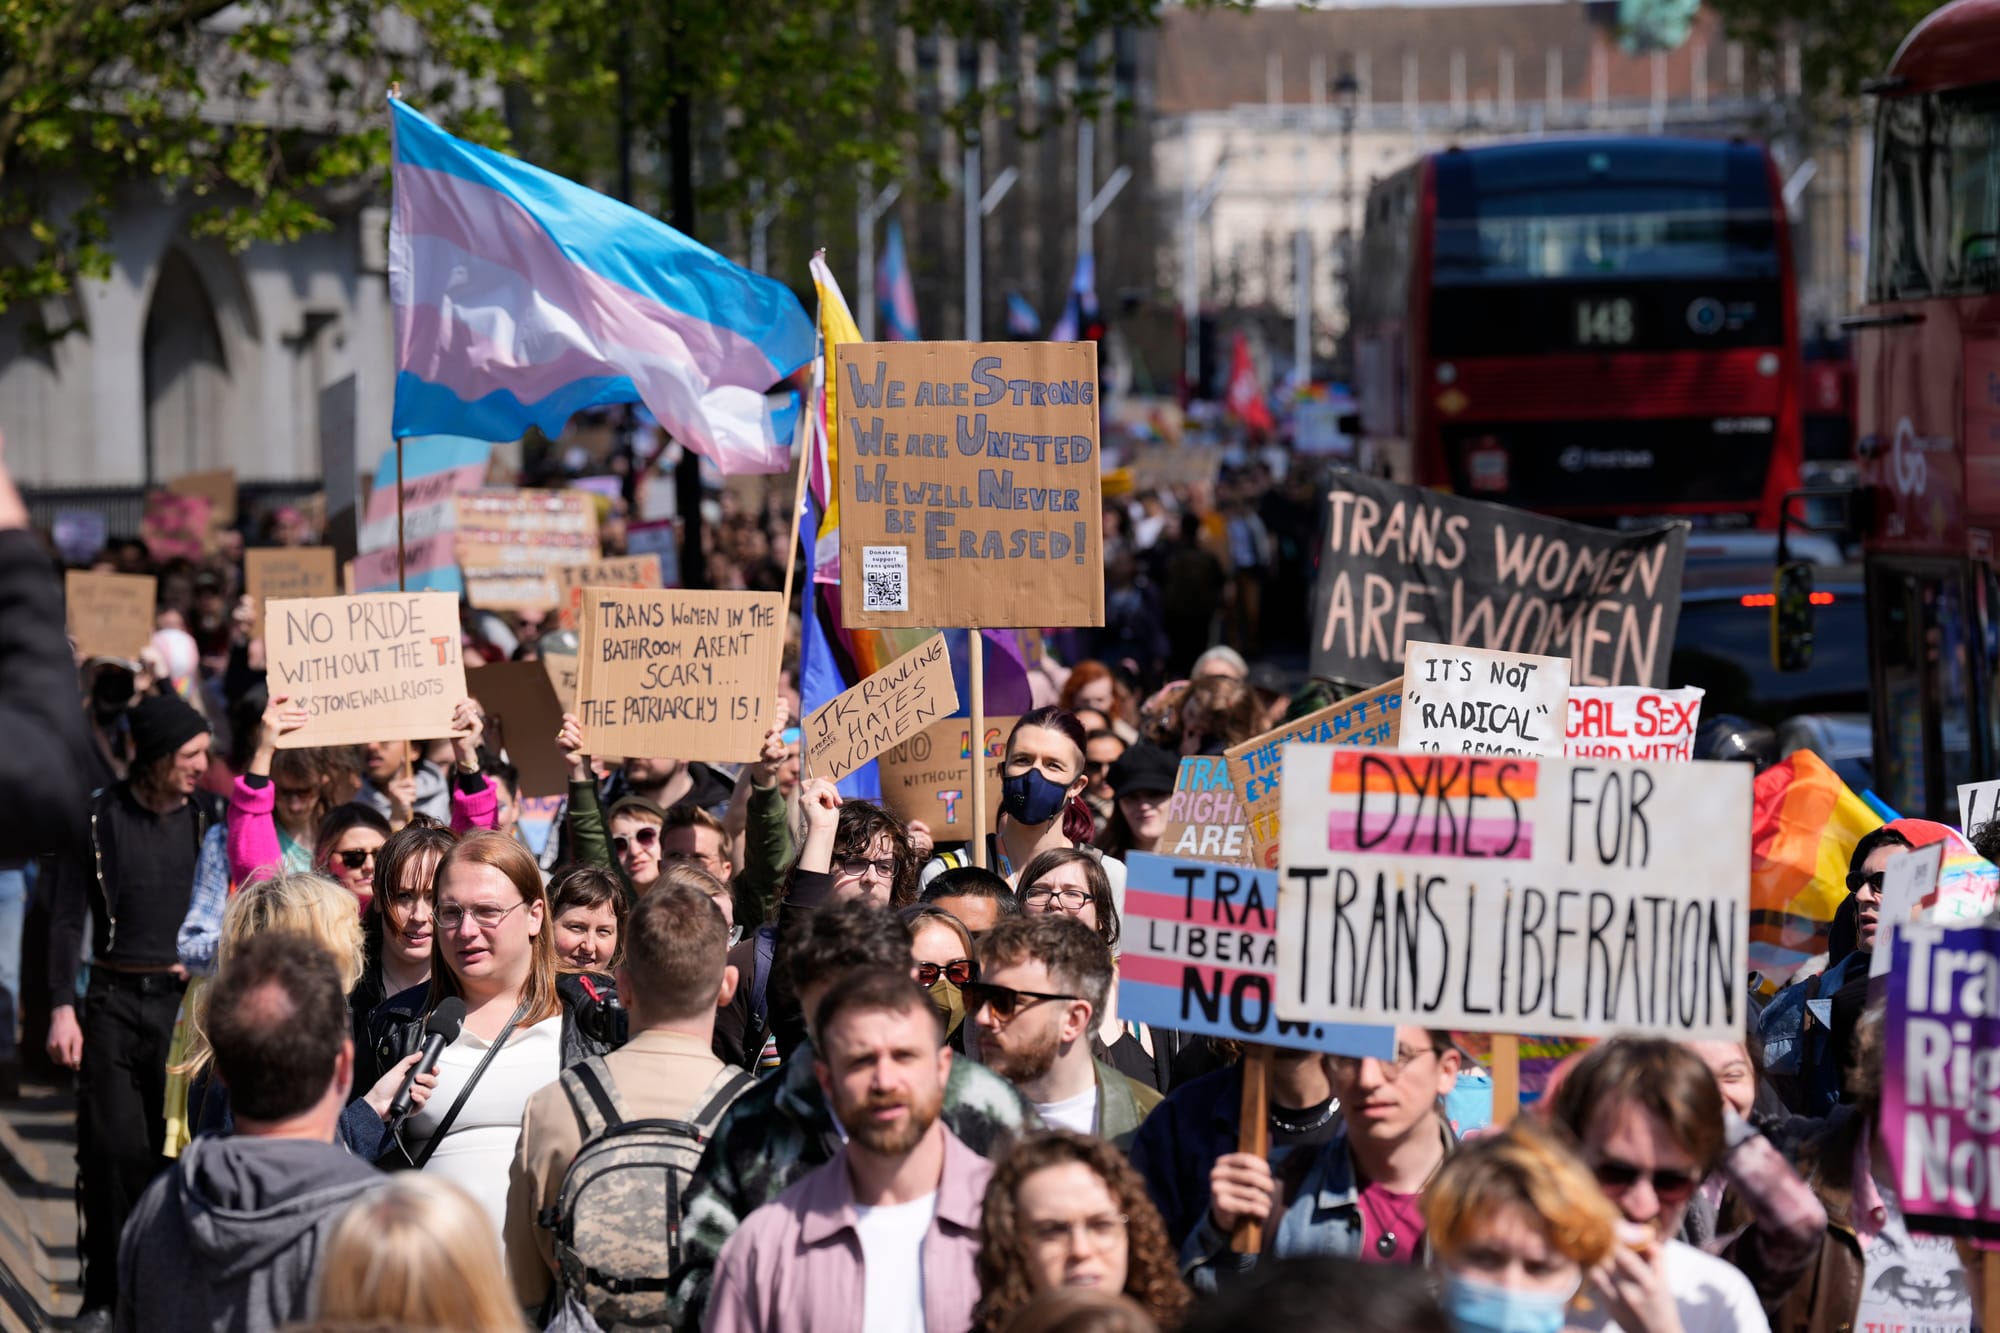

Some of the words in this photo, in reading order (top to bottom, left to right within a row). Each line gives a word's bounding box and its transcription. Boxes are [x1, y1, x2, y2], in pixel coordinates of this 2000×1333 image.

[1578, 297, 1634, 345] 148
[847, 361, 906, 408] WE
[914, 381, 969, 407] ARE
[970, 356, 1094, 408] STRONG
[849, 416, 900, 457] WE
[905, 433, 949, 459] ARE
[956, 413, 1093, 465] UNITED
[854, 463, 899, 506] WE
[902, 481, 973, 509] WILL
[977, 468, 1081, 513] NEVER
[884, 508, 917, 534] BE
[924, 510, 1087, 565] ERASED!
[1328, 490, 1470, 570] TRANS
[1494, 524, 1668, 599] WOMEN
[286, 607, 334, 646] NO
[346, 597, 426, 641] PRIDE
[600, 601, 664, 629] TRANS
[671, 603, 719, 627] WOMEN
[727, 607, 744, 628] IN
[749, 603, 775, 628] THE
[1322, 570, 1438, 664] ARE
[1450, 576, 1664, 687] WOMEN
[278, 648, 380, 685] WITHOUT
[387, 640, 424, 669] THE
[602, 637, 682, 663] BATHROOM
[812, 694, 860, 737] JK
[862, 639, 943, 705] ROWLING
[1425, 658, 1472, 682] IT'S
[1490, 662, 1538, 693] NOT
[581, 699, 617, 728] THE
[623, 696, 718, 726] PATRIARCHY
[731, 696, 761, 723] IS!
[848, 675, 927, 744] HATES
[1297, 701, 1369, 743] WANT
[1373, 693, 1403, 715] TO
[1634, 694, 1700, 737] SEX
[829, 696, 936, 780] WOMEN
[889, 730, 932, 765] NO
[903, 768, 968, 787] WITHOUT
[1179, 757, 1235, 792] TRA
[937, 789, 963, 825] T
[1355, 754, 1522, 860] DYKES
[1568, 766, 1655, 869] FOR
[1173, 824, 1246, 857] ARE
[1172, 866, 1278, 930] TRA
[1148, 920, 1278, 966] LIBERA
[1287, 865, 1449, 1013] TRANS
[1899, 927, 2000, 1019] Tra
[1905, 1016, 2000, 1134] Rig
[1902, 1110, 2000, 1211] No
